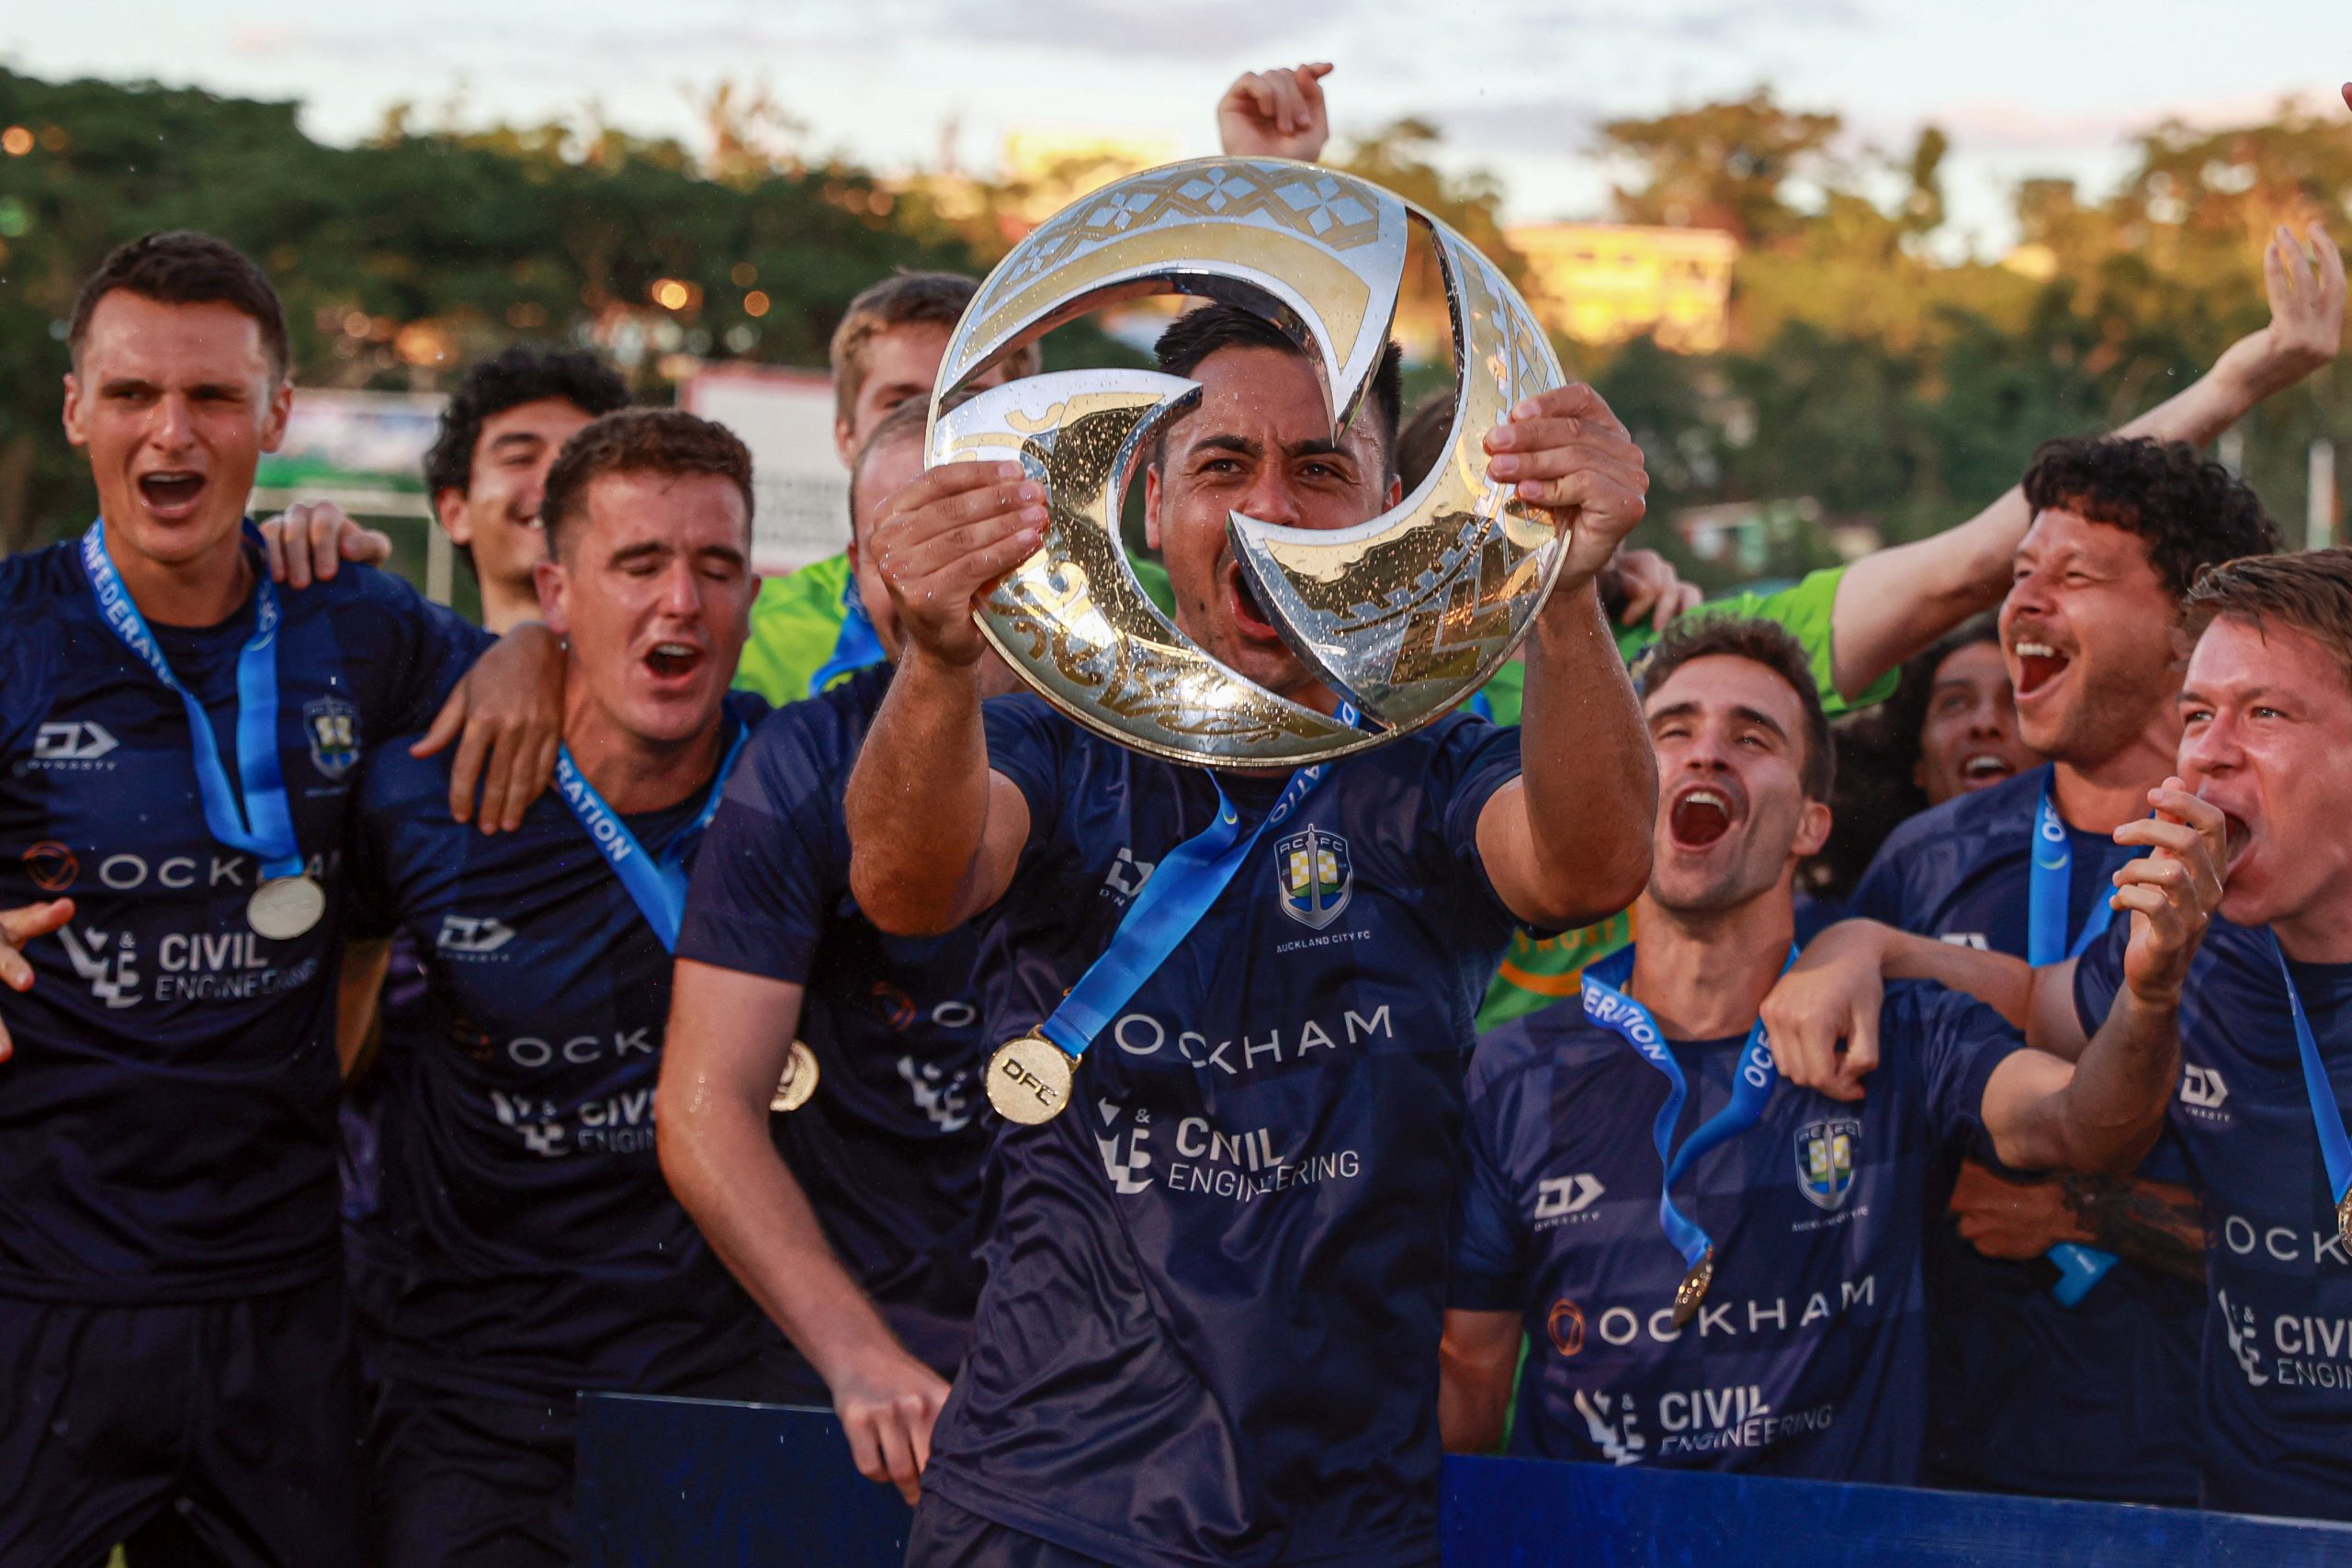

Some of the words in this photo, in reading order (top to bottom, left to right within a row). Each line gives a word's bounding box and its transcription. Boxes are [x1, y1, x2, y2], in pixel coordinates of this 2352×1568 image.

[159, 933, 268, 972] CIVIL
[1276, 936, 1329, 953] AUCKLAND
[1332, 931, 1355, 943] CITY
[1357, 930, 1371, 941] FC
[1114, 1005, 1393, 1075] OCKHAM
[1599, 1275, 1876, 1346] OCKHAM
[1659, 1384, 1770, 1432] CIVIL
